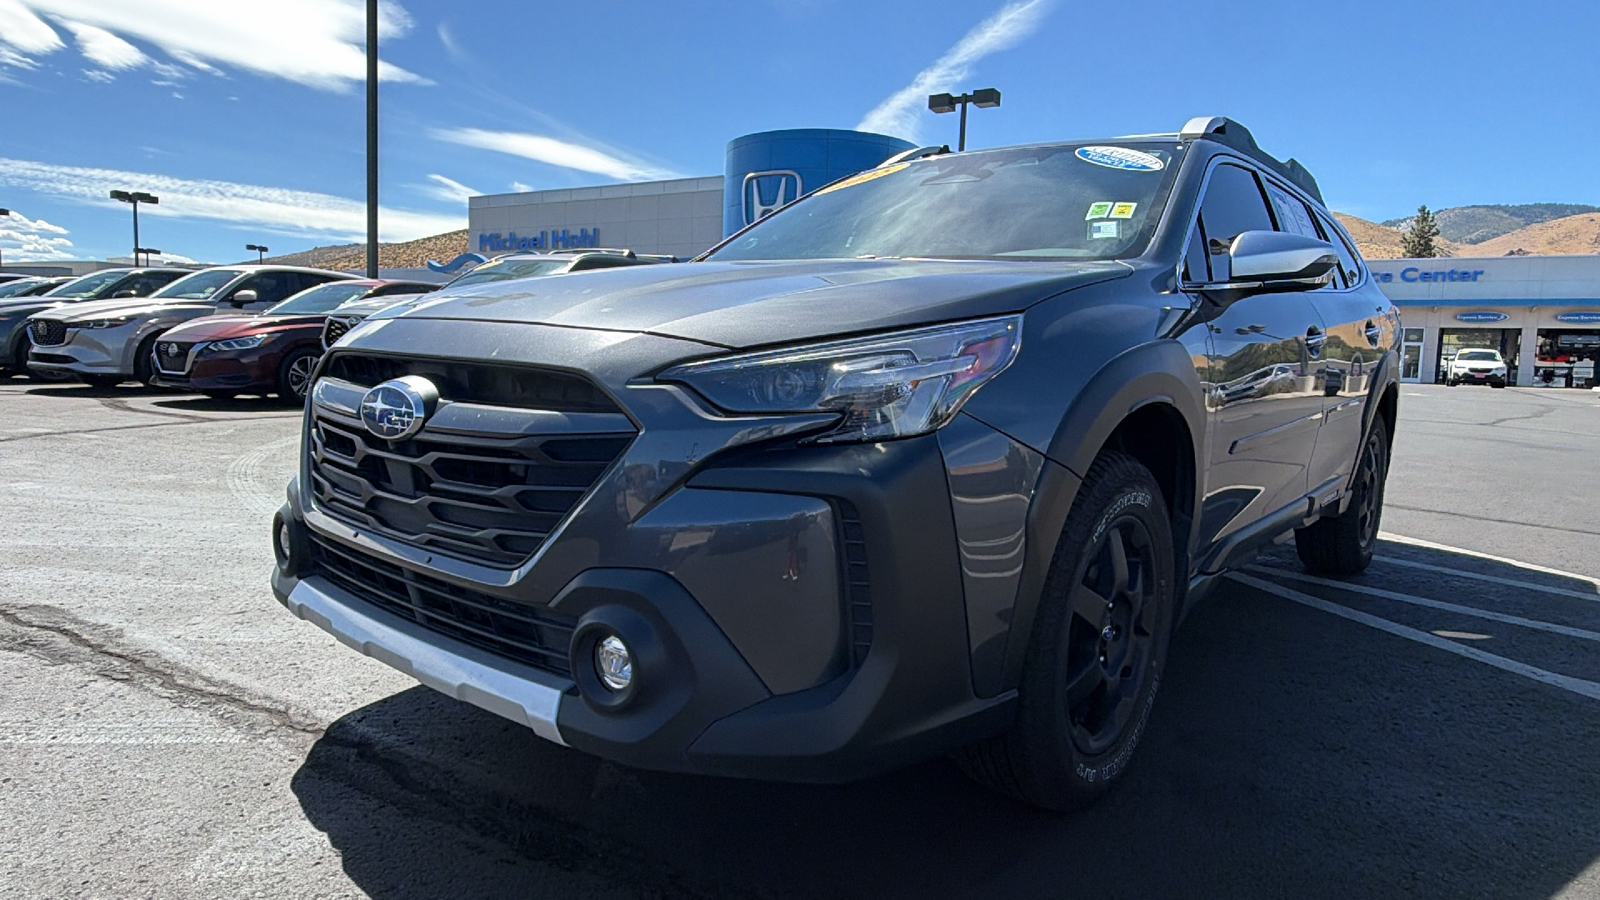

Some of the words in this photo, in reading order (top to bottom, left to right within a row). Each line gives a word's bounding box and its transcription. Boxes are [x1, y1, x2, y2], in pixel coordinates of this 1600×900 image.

[478, 230, 545, 251] Michael
[551, 227, 598, 249] Hohl
[1400, 267, 1484, 282] Center
